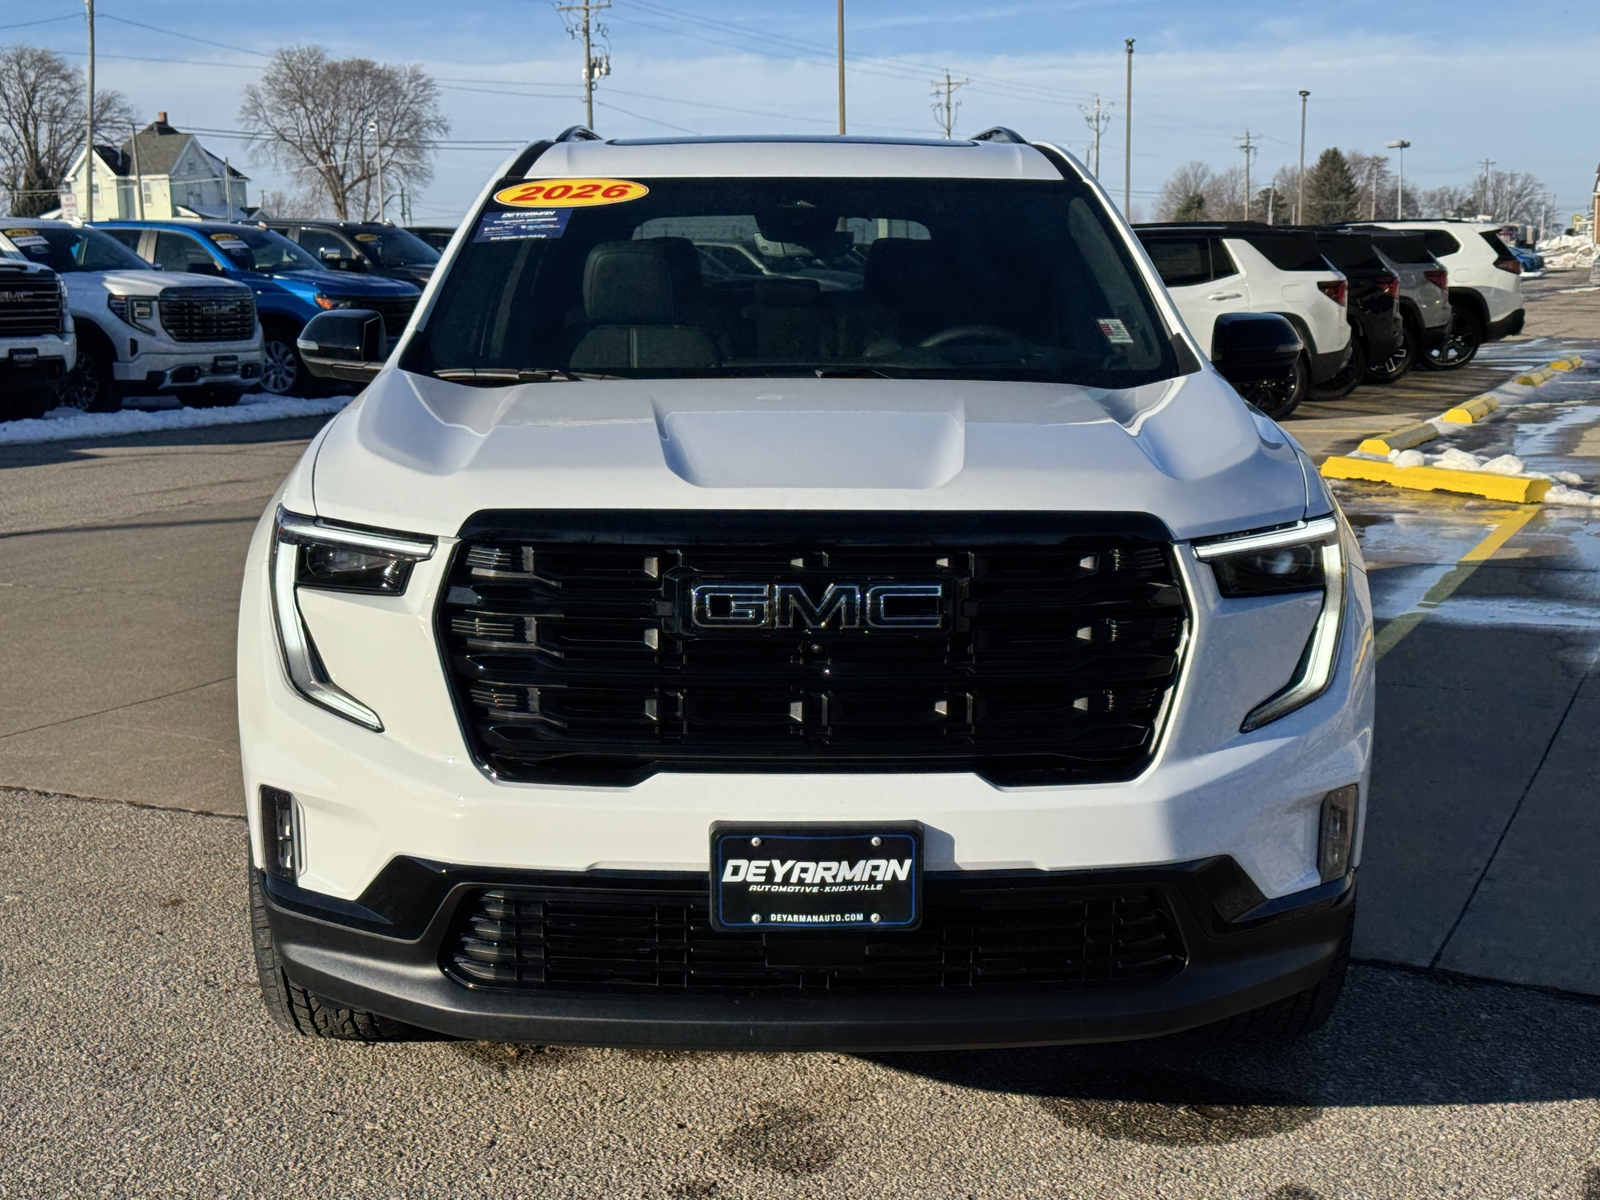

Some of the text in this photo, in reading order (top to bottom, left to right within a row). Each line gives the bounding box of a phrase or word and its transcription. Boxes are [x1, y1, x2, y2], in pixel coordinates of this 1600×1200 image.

[509, 183, 634, 202] 2026
[692, 584, 943, 629] GMC
[721, 858, 913, 884] DEYARMAN
[770, 913, 864, 923] DEYARMANAUTO.COM
